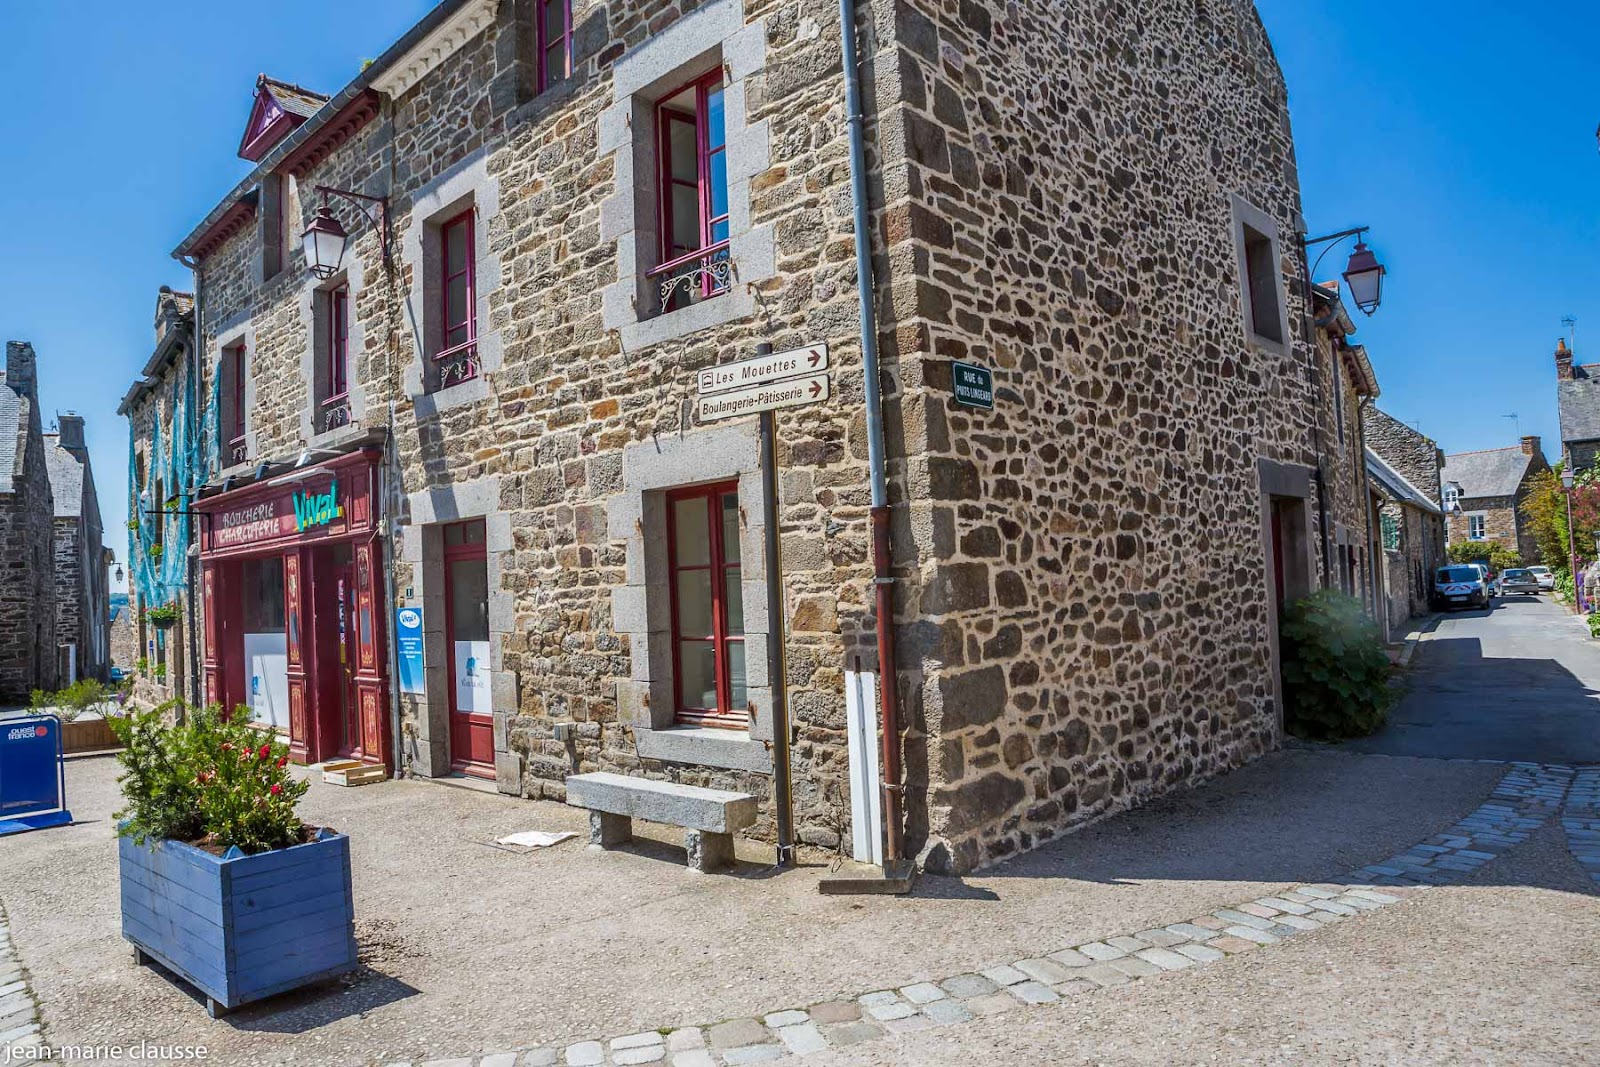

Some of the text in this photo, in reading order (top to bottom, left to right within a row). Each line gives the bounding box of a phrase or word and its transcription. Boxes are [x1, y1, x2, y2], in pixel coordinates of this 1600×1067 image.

[716, 359, 797, 384] Les Mouettes
[964, 371, 976, 384] RUE
[702, 386, 803, 416] Boulangerie-Pâtisserie
[222, 502, 274, 528] BOUCHERIE
[292, 479, 338, 532] Vival
[220, 518, 280, 542] CHARCUTERIE
[10, 725, 34, 734] ouest
